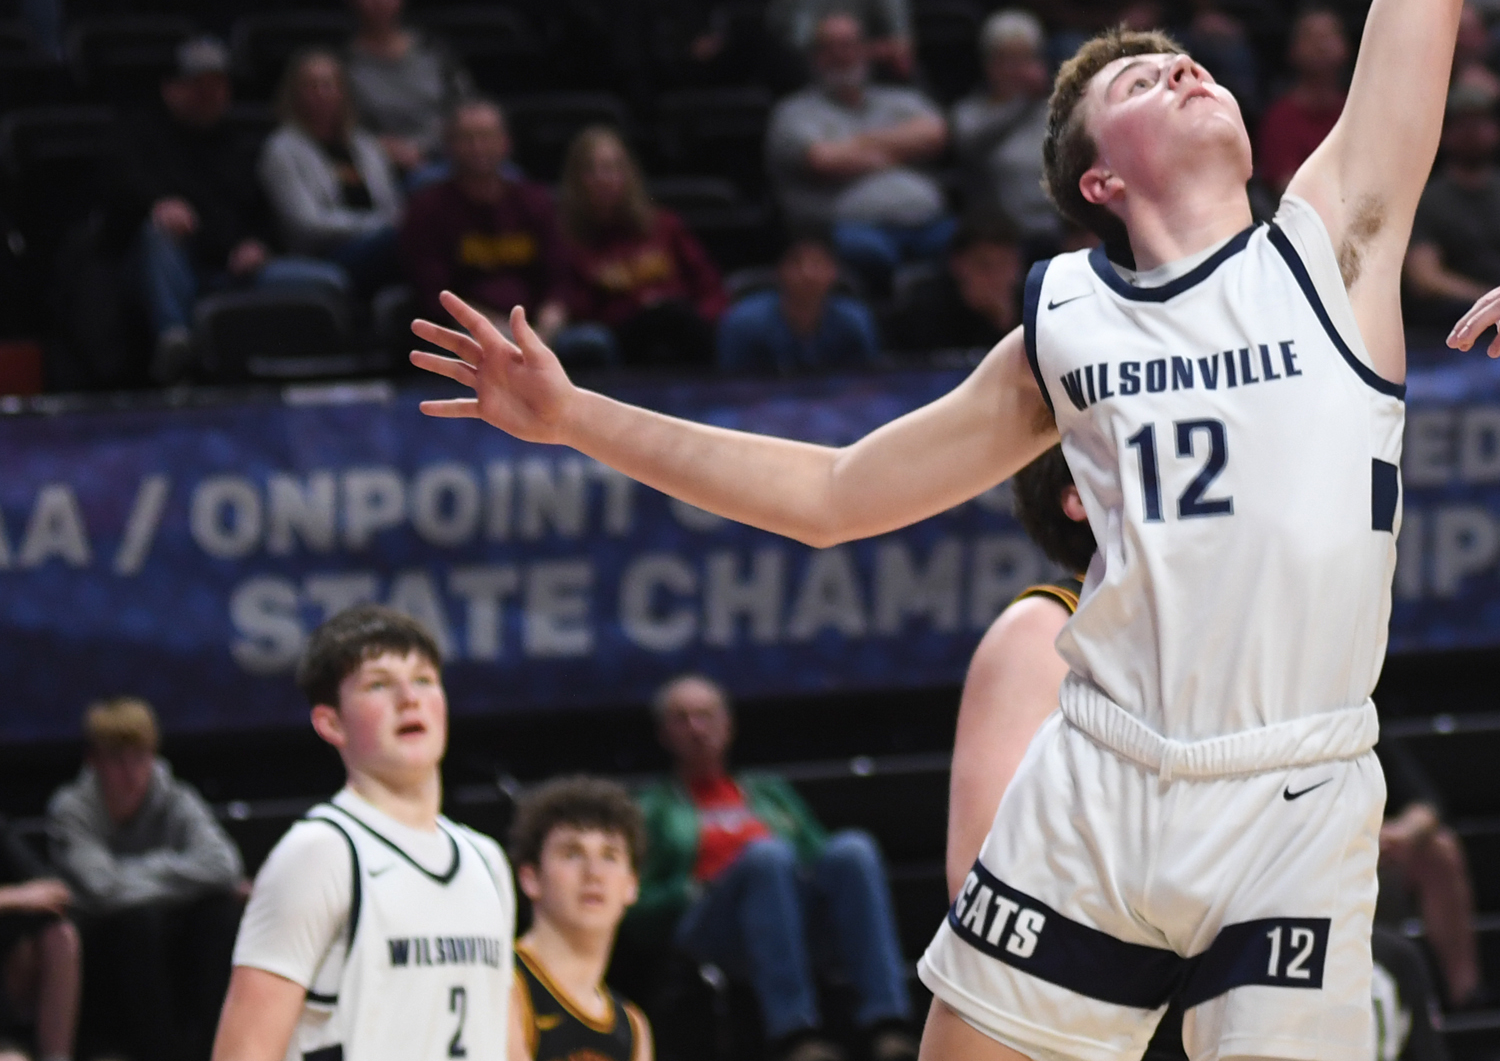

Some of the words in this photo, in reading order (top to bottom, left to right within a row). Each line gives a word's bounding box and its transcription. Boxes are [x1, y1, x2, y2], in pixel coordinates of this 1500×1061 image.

[1060, 340, 1303, 412] WILSONVILLE
[190, 456, 634, 560] ONPOINT
[1125, 417, 1235, 524] 12
[955, 871, 1046, 958] CATS
[1266, 926, 1315, 979] 12
[447, 986, 466, 1058] 2
